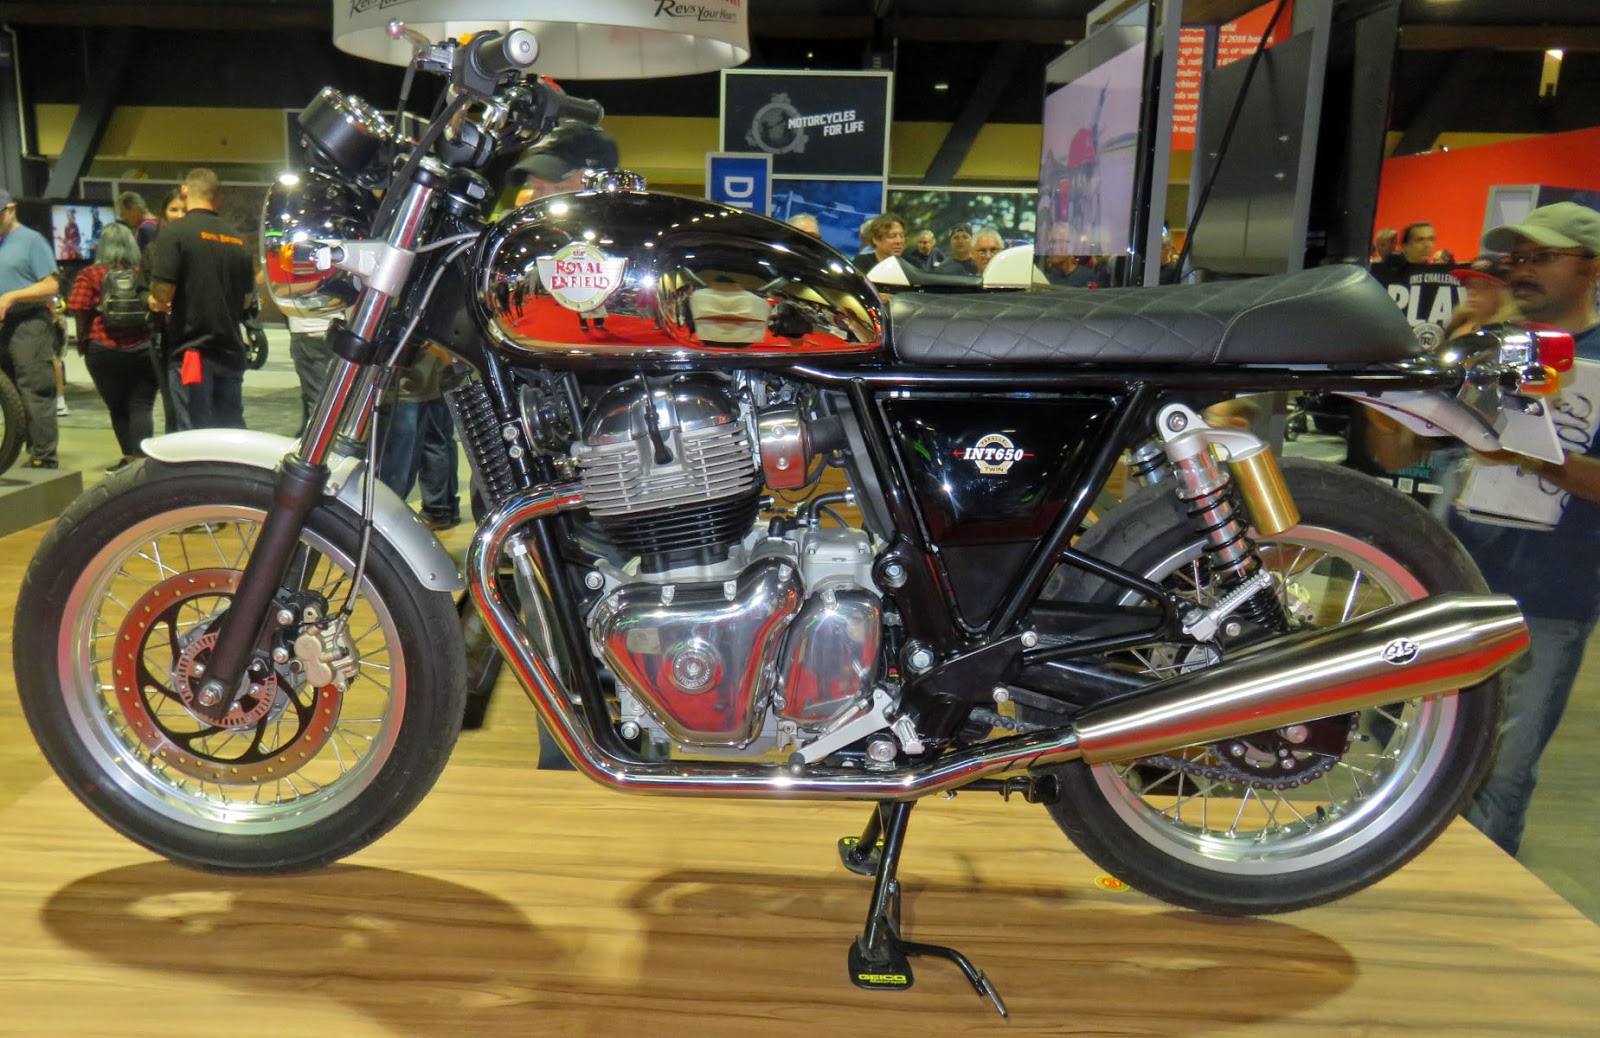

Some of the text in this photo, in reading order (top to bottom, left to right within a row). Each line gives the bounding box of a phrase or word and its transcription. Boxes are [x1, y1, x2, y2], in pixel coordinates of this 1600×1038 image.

[788, 110, 857, 129] MOTORCYCLES
[823, 121, 865, 137] FOR LIFE
[556, 260, 604, 275] ROYAL
[551, 276, 611, 290] ENFIELD
[963, 447, 1024, 461] INT650
